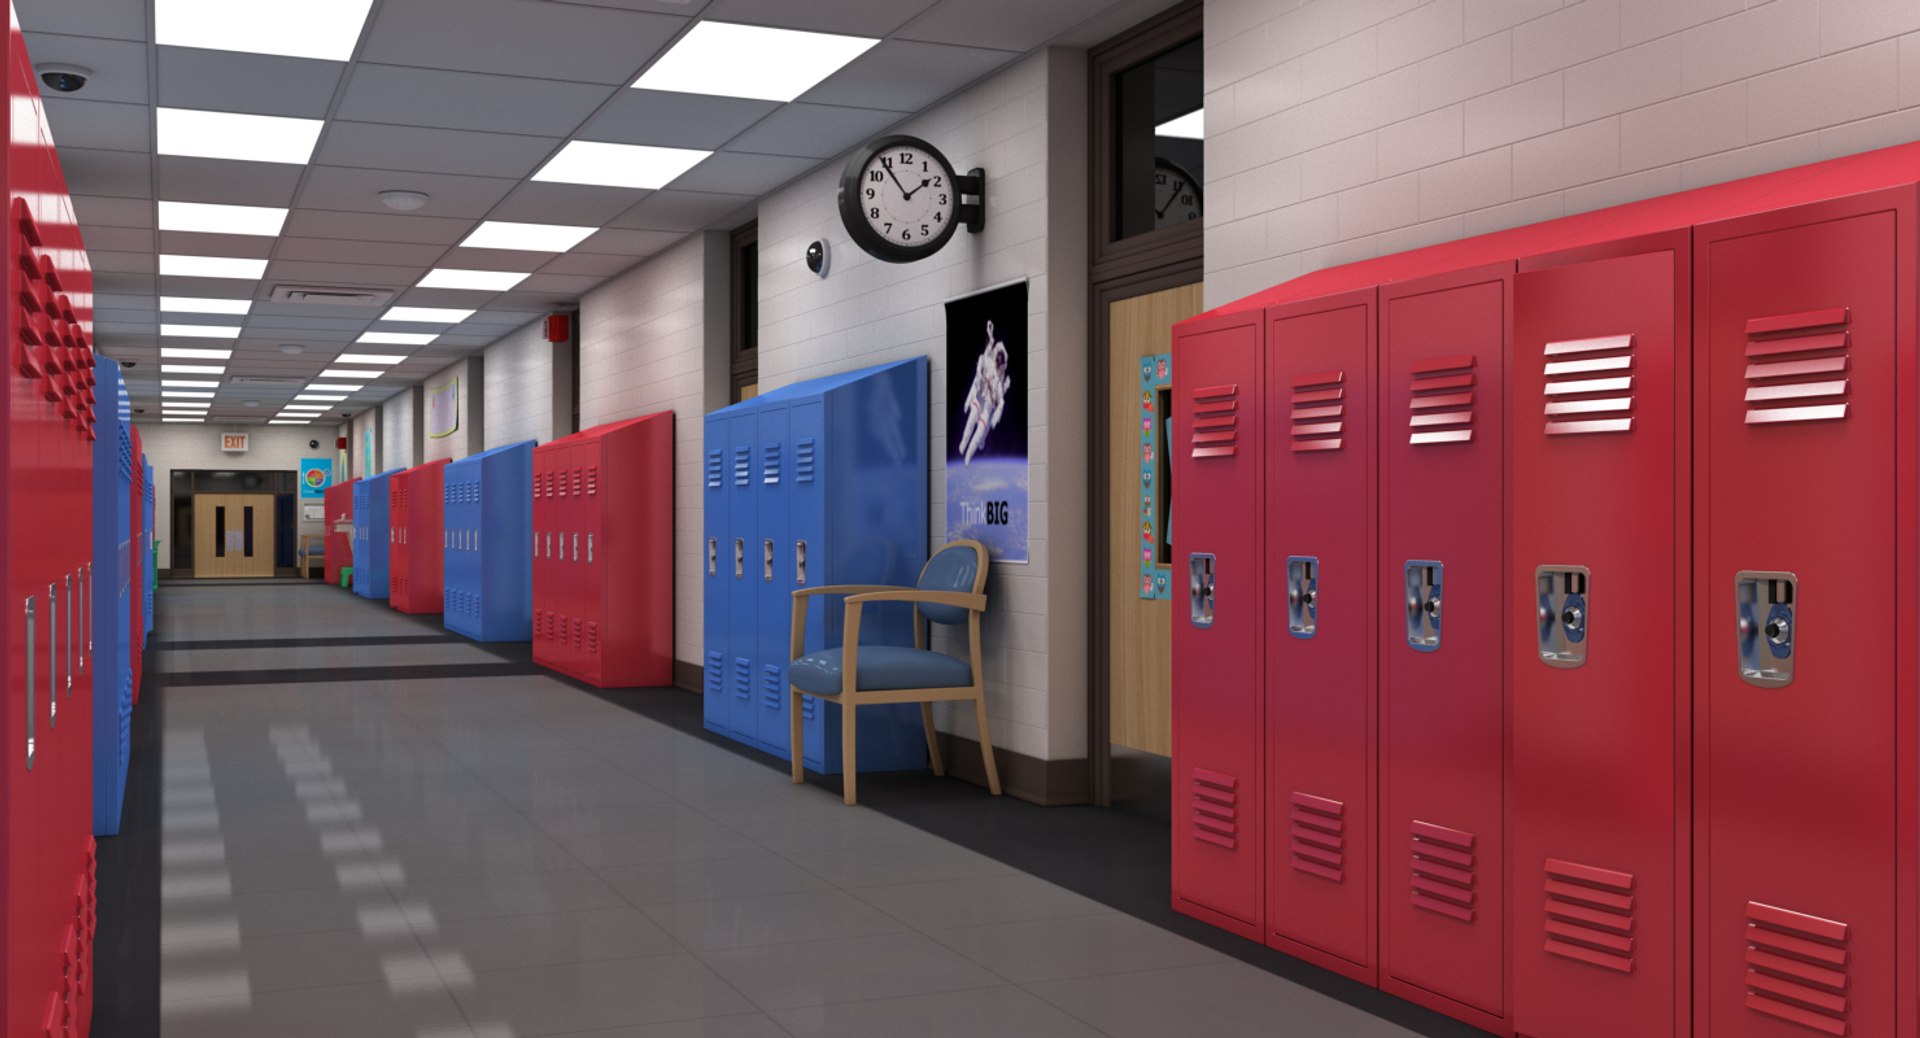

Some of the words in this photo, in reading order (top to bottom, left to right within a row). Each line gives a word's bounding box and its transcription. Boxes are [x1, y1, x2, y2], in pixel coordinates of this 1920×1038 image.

[881, 157, 893, 169] 11
[900, 153, 913, 165] 12
[922, 161, 929, 172] 1
[869, 171, 884, 182] 10
[933, 176, 942, 187] 2
[866, 188, 875, 199] 9
[939, 194, 947, 205] 3
[870, 207, 880, 219] 8
[933, 212, 943, 223] 4
[884, 223, 893, 234] 7
[920, 224, 929, 236] 5
[902, 229, 911, 240] 6
[224, 435, 246, 449] EXIT
